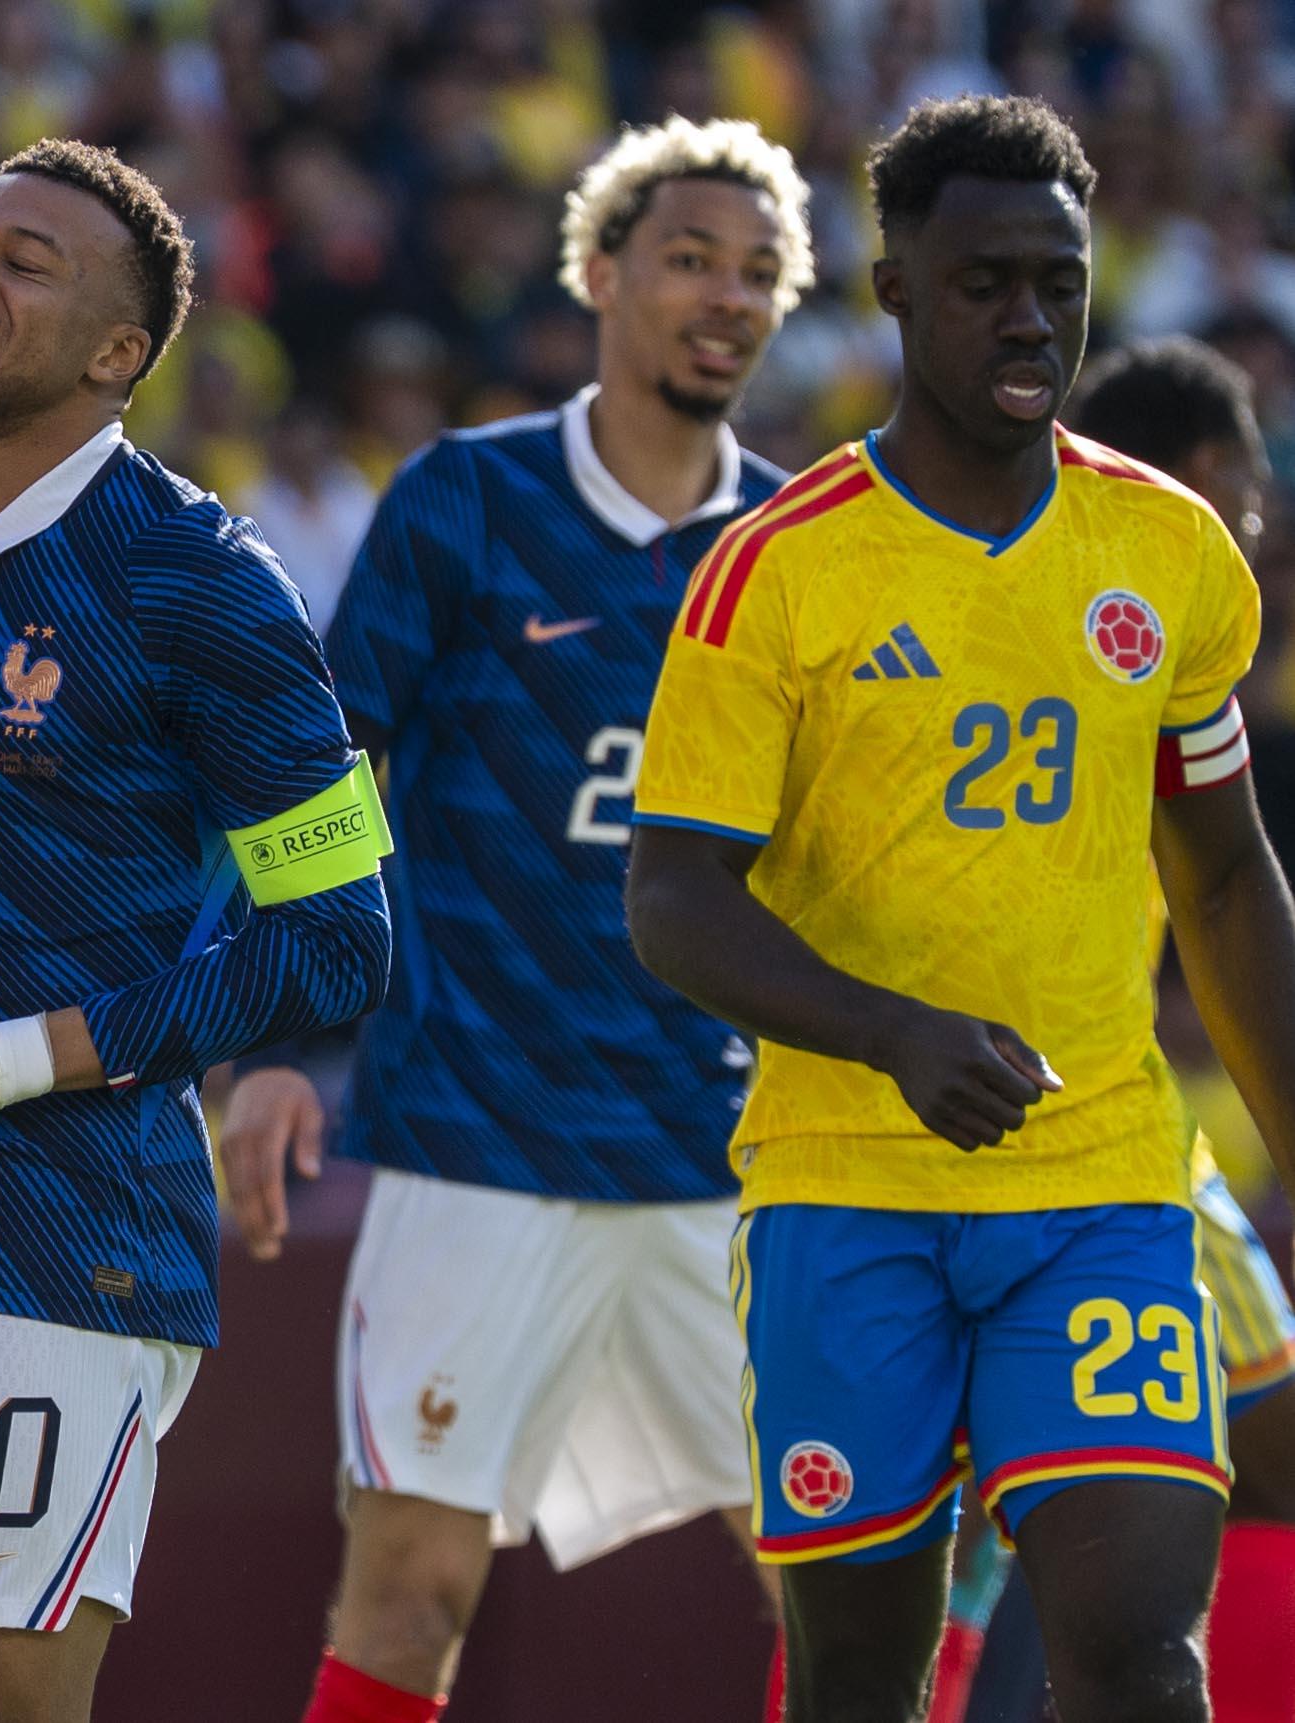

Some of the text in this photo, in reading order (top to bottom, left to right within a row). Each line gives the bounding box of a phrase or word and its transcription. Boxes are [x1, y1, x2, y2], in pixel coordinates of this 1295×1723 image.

[4, 725, 38, 739] FFF
[944, 695, 1079, 830] 23
[282, 810, 366, 856] RESPECT
[1067, 1296, 1202, 1423] 23
